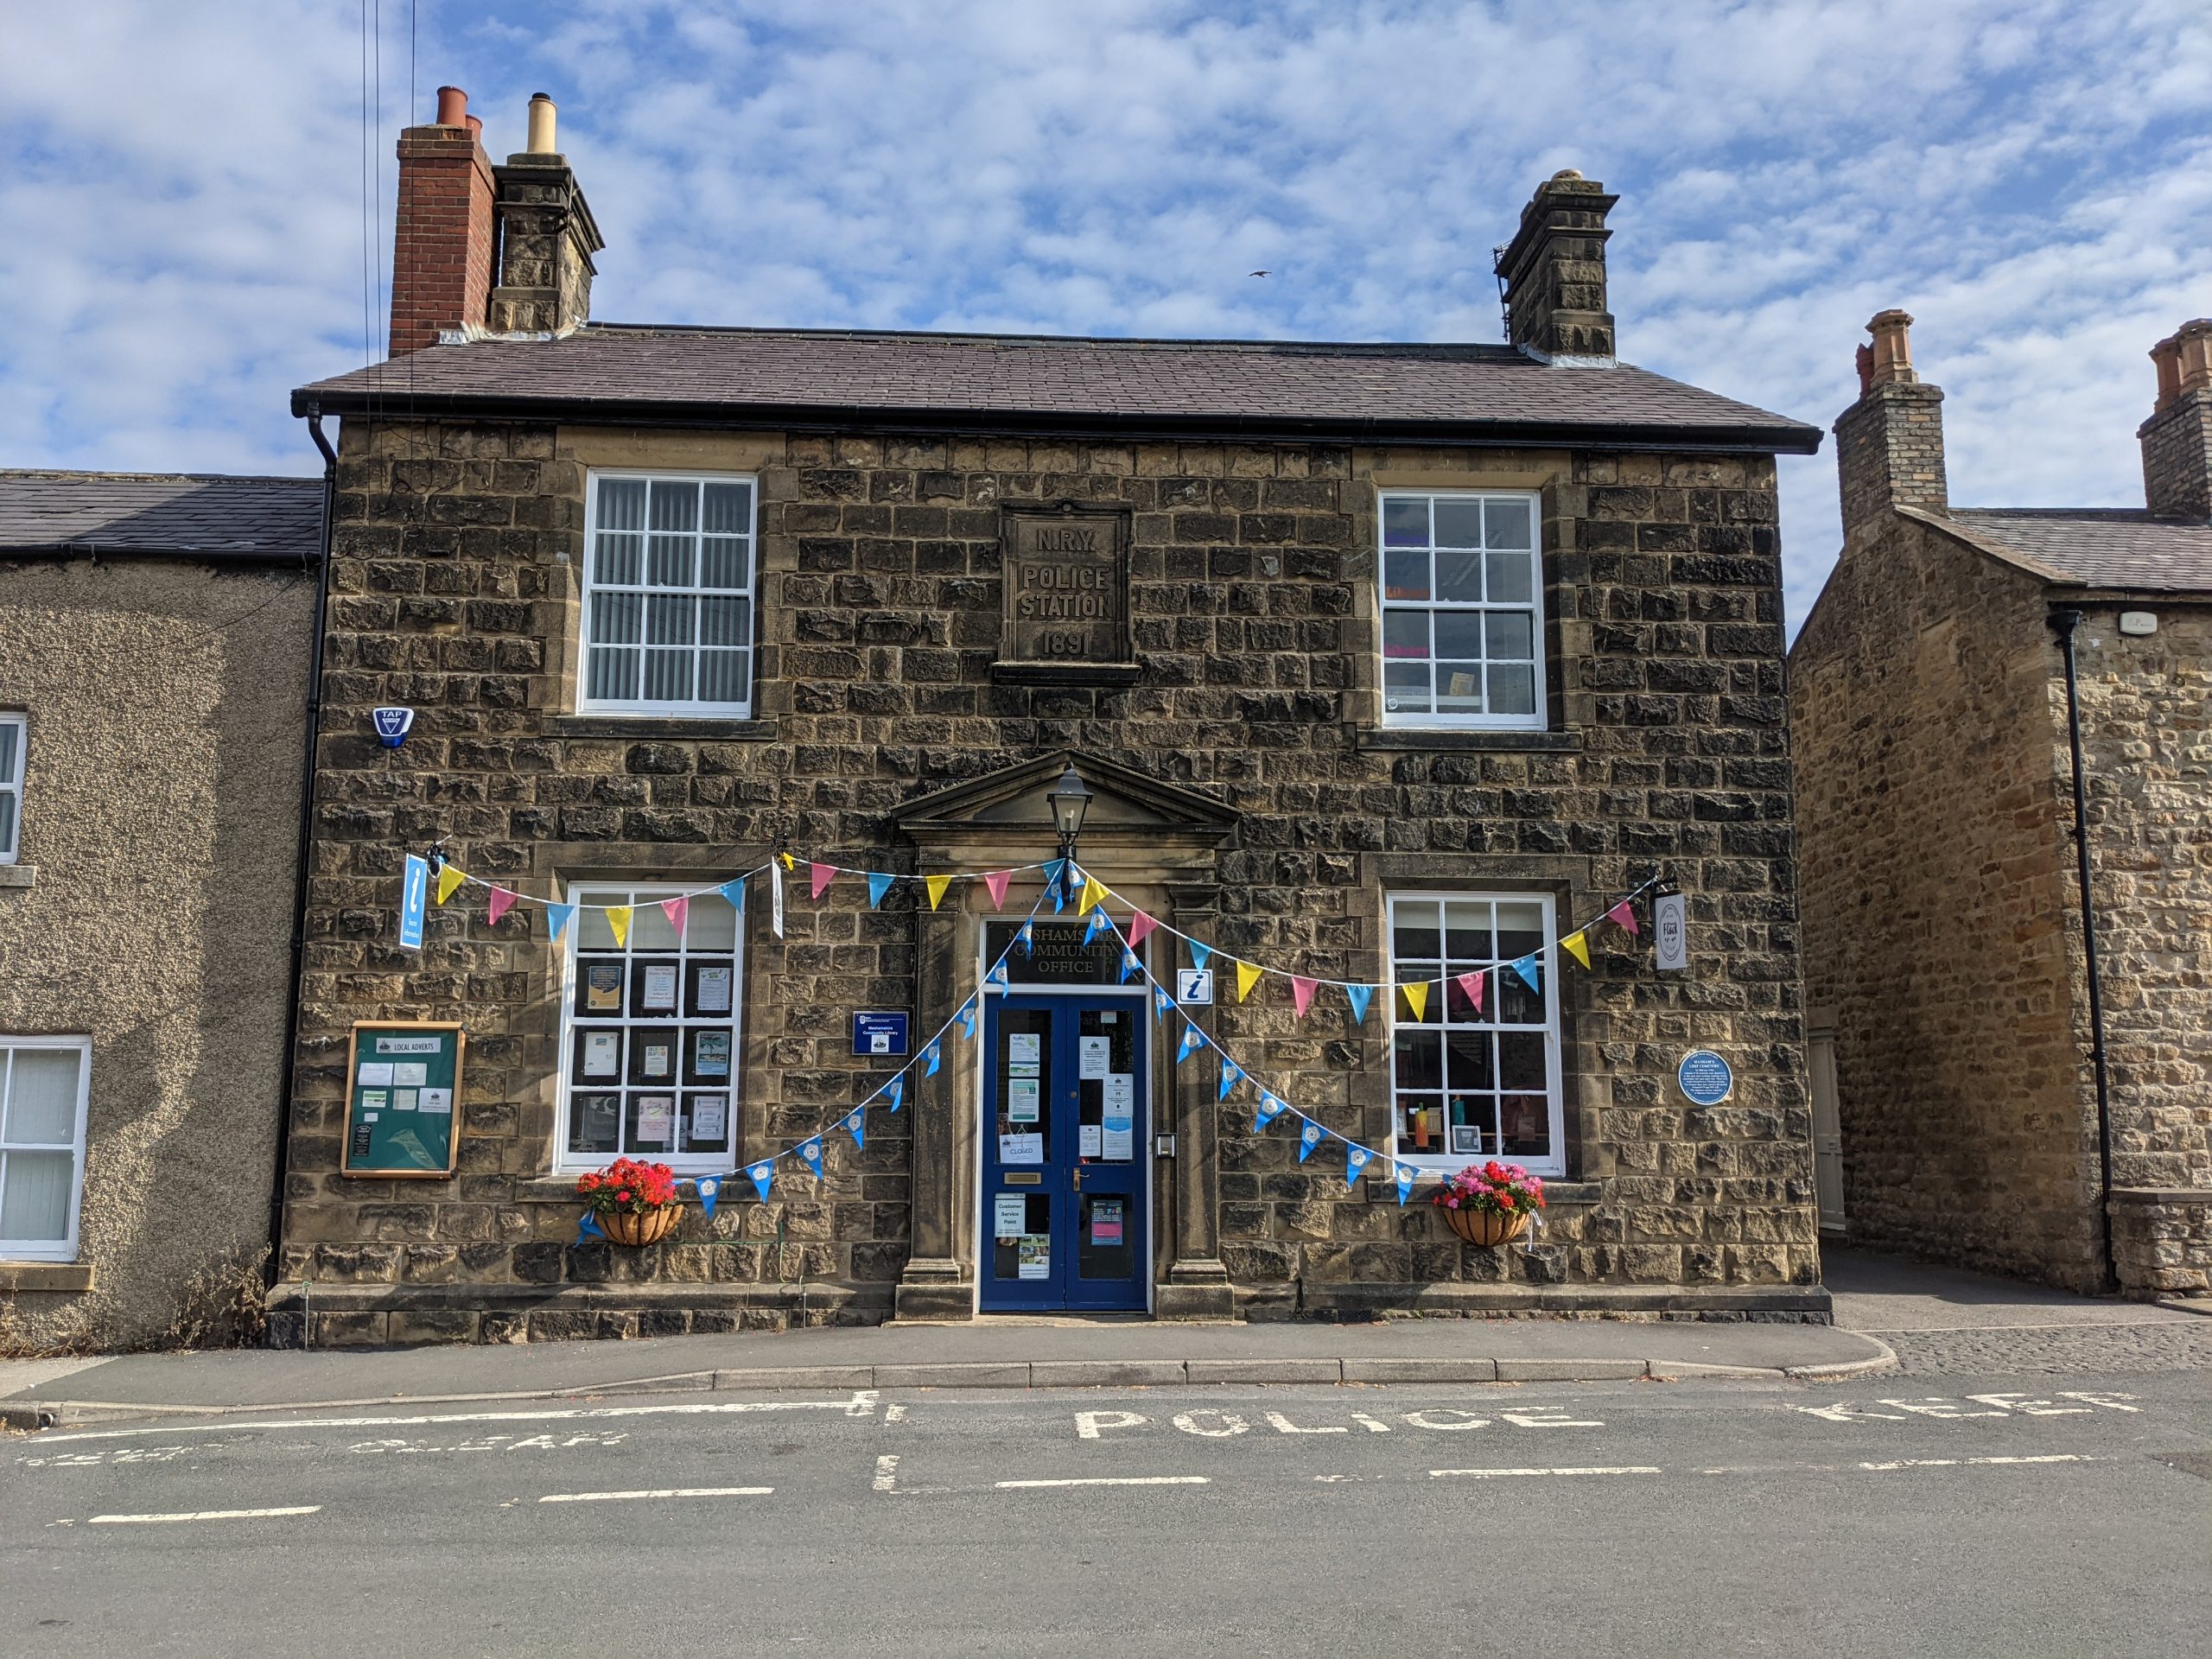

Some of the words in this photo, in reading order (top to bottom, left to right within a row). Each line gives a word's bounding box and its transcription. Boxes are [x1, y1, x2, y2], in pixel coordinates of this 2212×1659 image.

[1038, 529, 1096, 551] N.R.Y.
[1023, 566, 1110, 590] POLICE
[1020, 594, 1113, 618] STATION
[1044, 632, 1092, 655] 1891
[1038, 961, 1094, 973] OFFICE
[1074, 1406, 1606, 1439] POLICE
